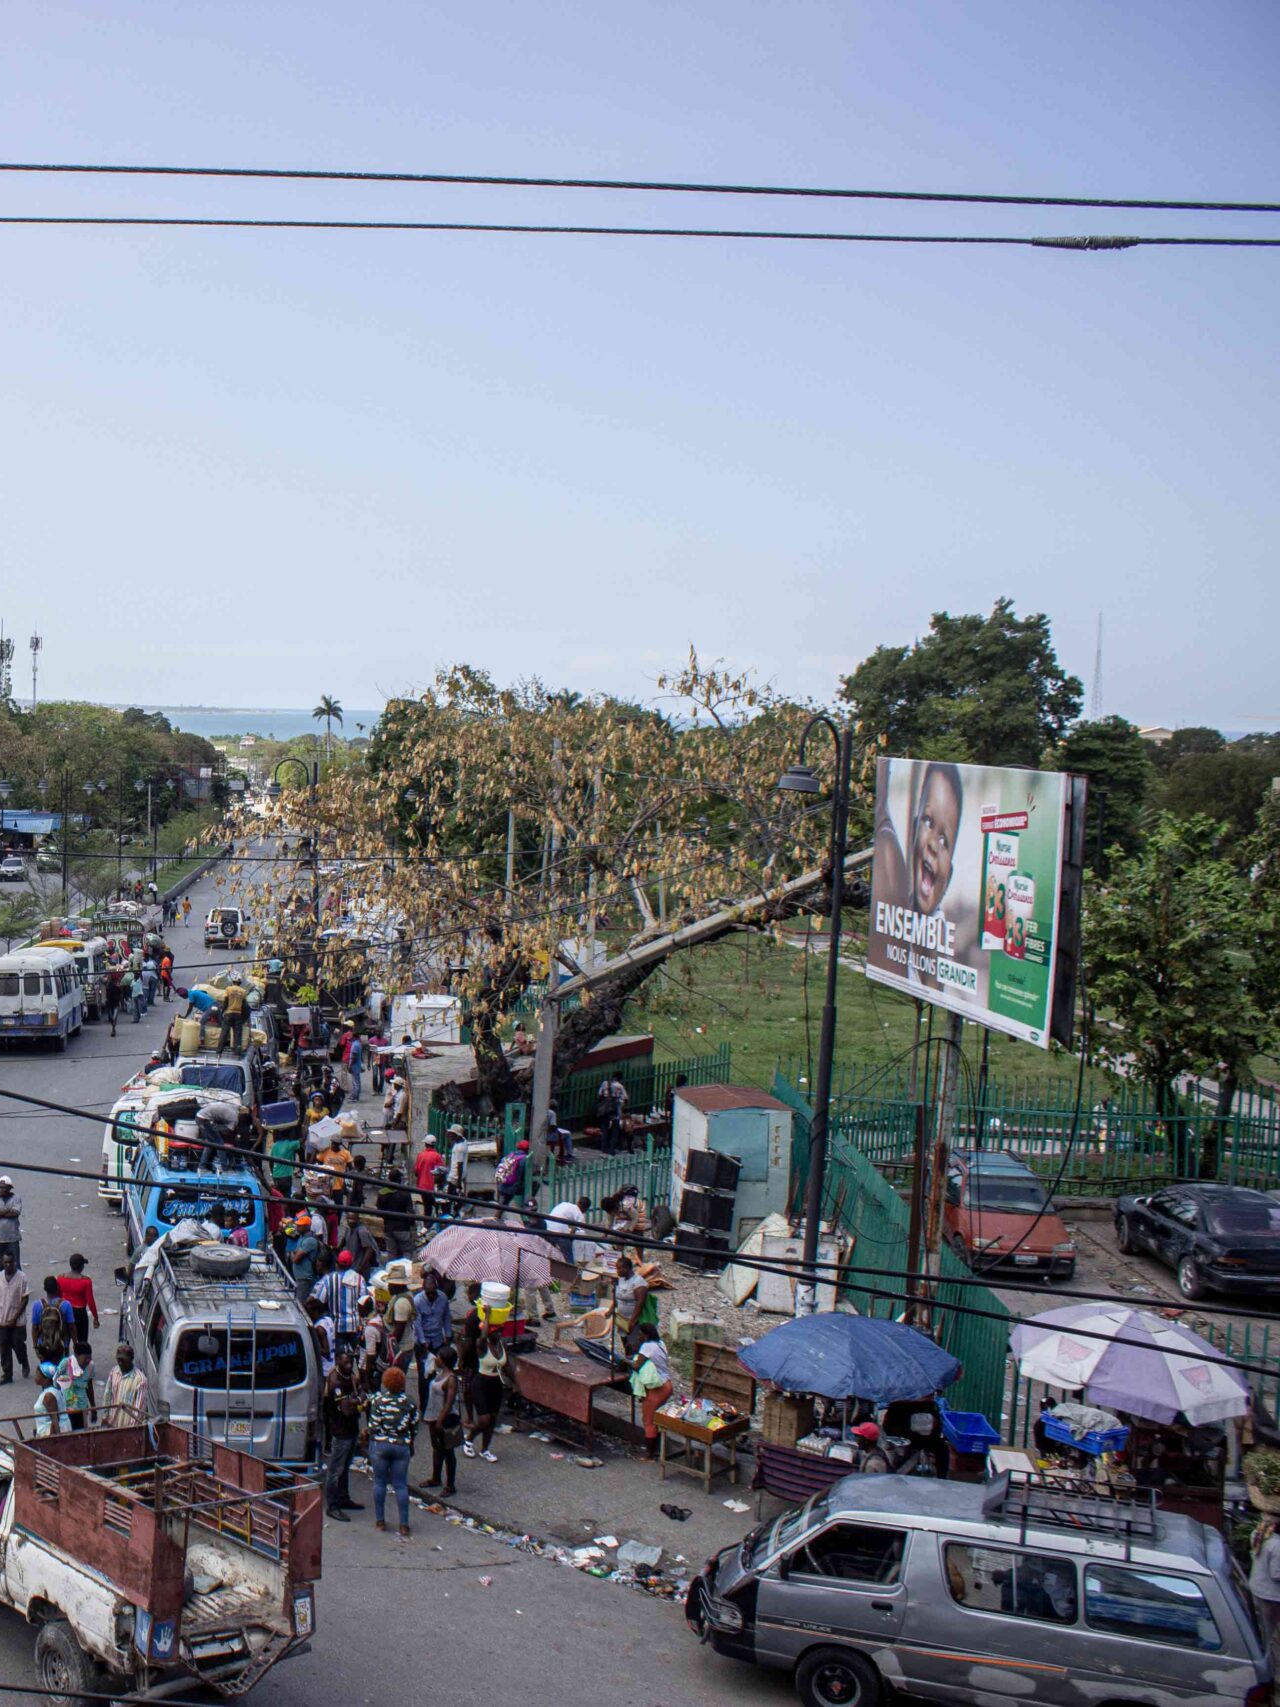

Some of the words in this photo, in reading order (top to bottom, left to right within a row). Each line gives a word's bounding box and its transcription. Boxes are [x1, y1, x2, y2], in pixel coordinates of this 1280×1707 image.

[876, 901, 956, 956] ENSEMBLE
[886, 943, 907, 965] NOUS
[907, 951, 936, 976] ALLONS
[939, 962, 976, 990] GRANDIR
